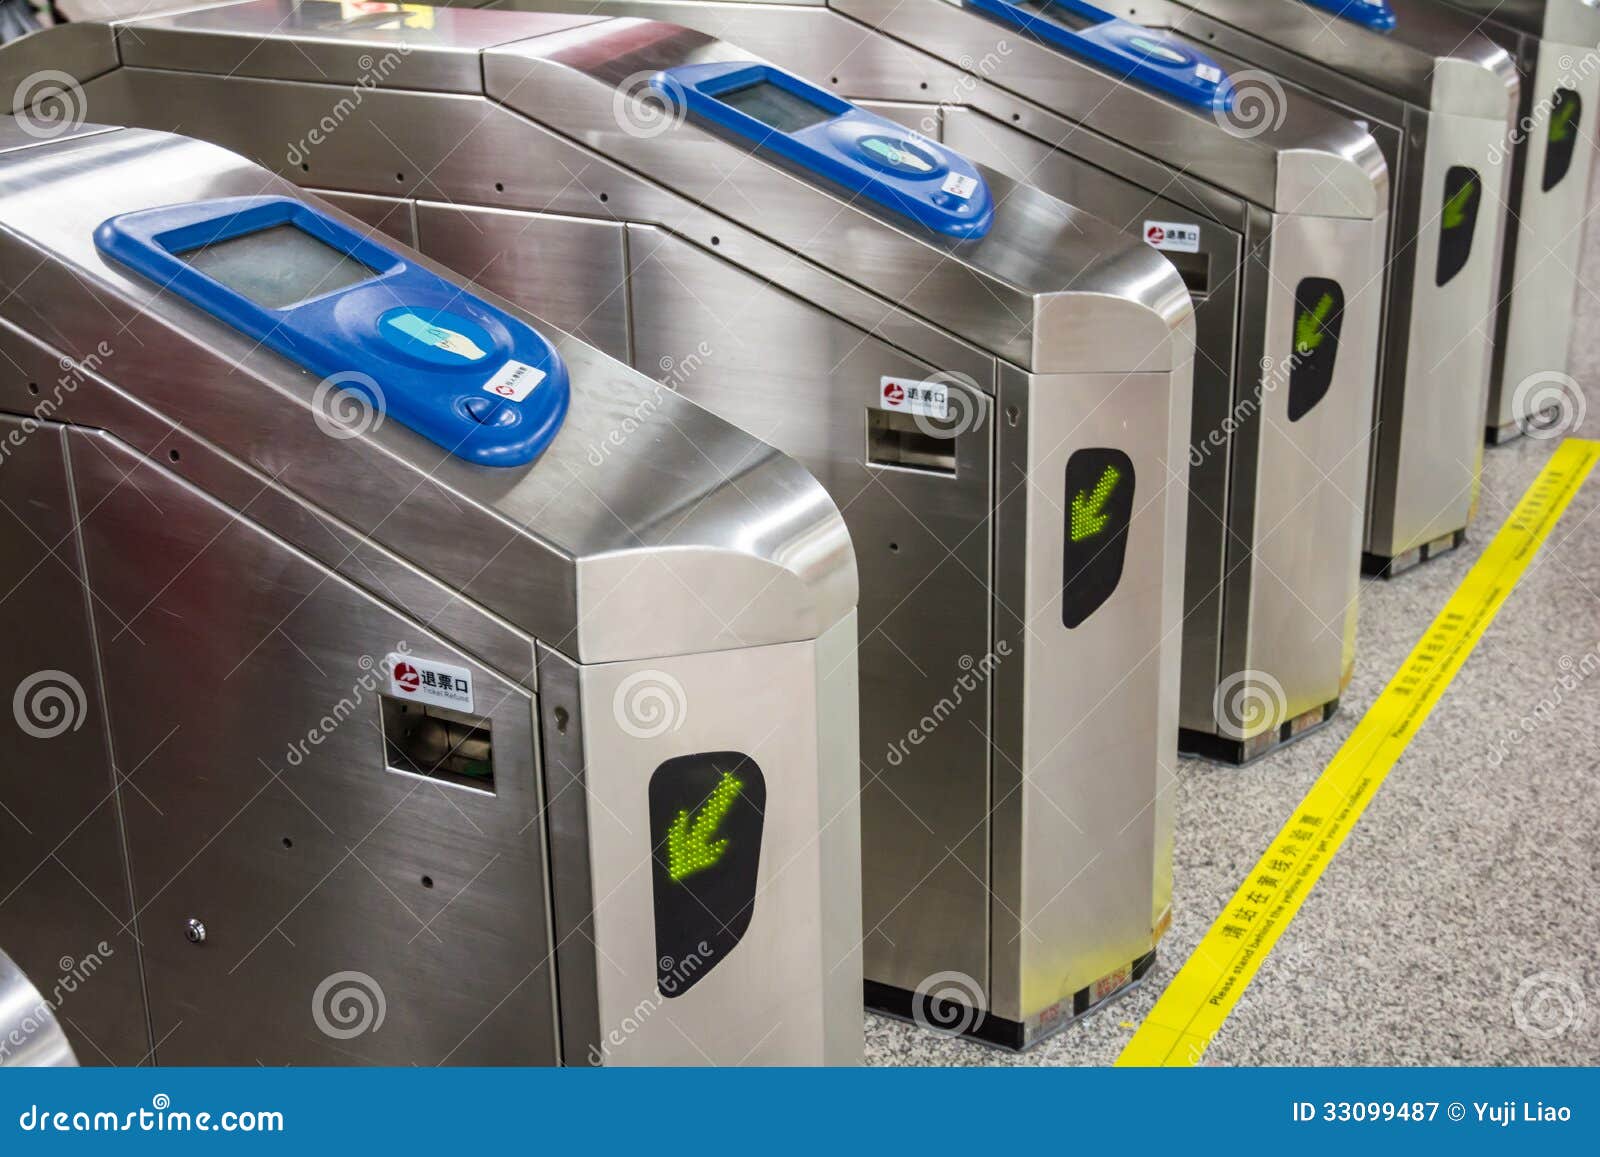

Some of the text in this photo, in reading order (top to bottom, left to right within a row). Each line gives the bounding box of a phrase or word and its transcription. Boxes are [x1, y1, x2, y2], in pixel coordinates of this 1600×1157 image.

[421, 670, 468, 694] 退票口
[1209, 976, 1236, 1006] Please
[1233, 948, 1255, 975] stand
[1247, 919, 1275, 950] behind
[1270, 904, 1285, 920] the
